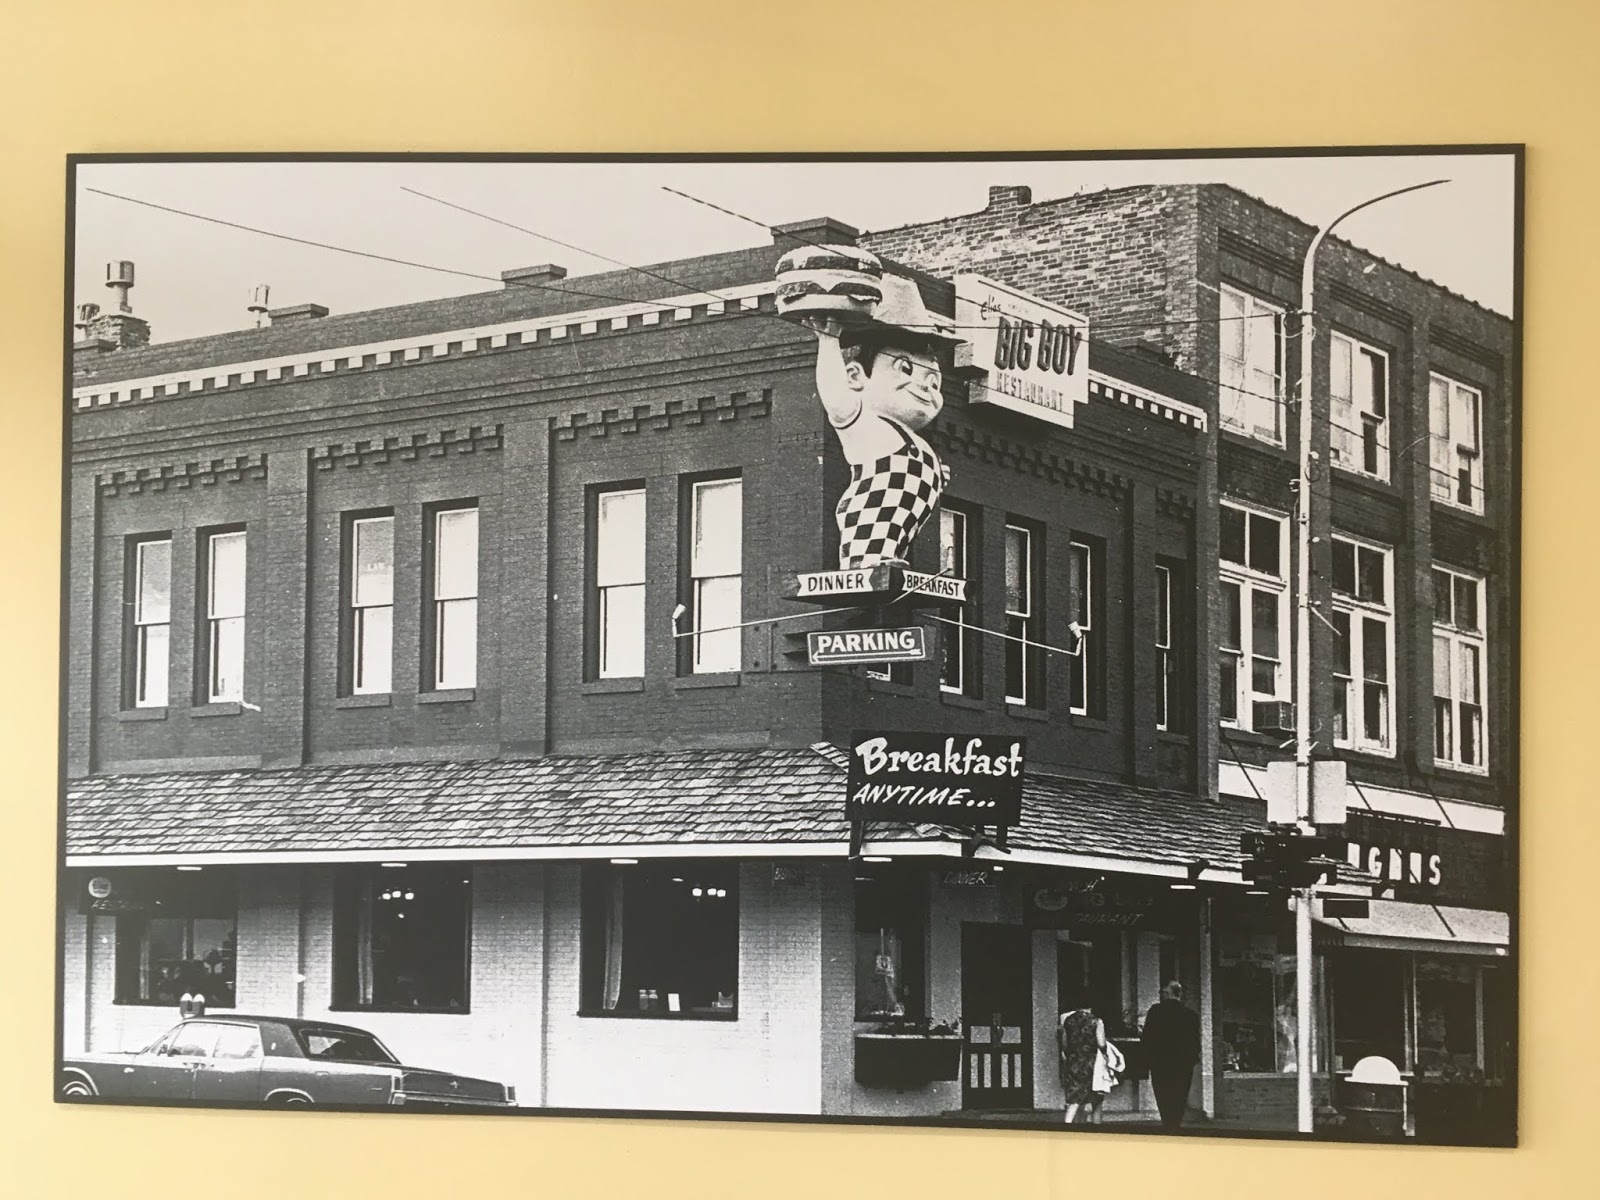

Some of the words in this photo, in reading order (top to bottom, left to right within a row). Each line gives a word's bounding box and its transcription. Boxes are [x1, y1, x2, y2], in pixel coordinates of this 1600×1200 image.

[994, 316, 1034, 371] BIG
[1037, 319, 1083, 376] BOY
[996, 371, 1064, 412] RESTAURANT
[808, 573, 865, 592] DINNER
[906, 574, 960, 597] BREAKFAST
[817, 631, 915, 653] PARKING
[854, 737, 1023, 777] Breakfast
[852, 783, 996, 807] ANYTIME...
